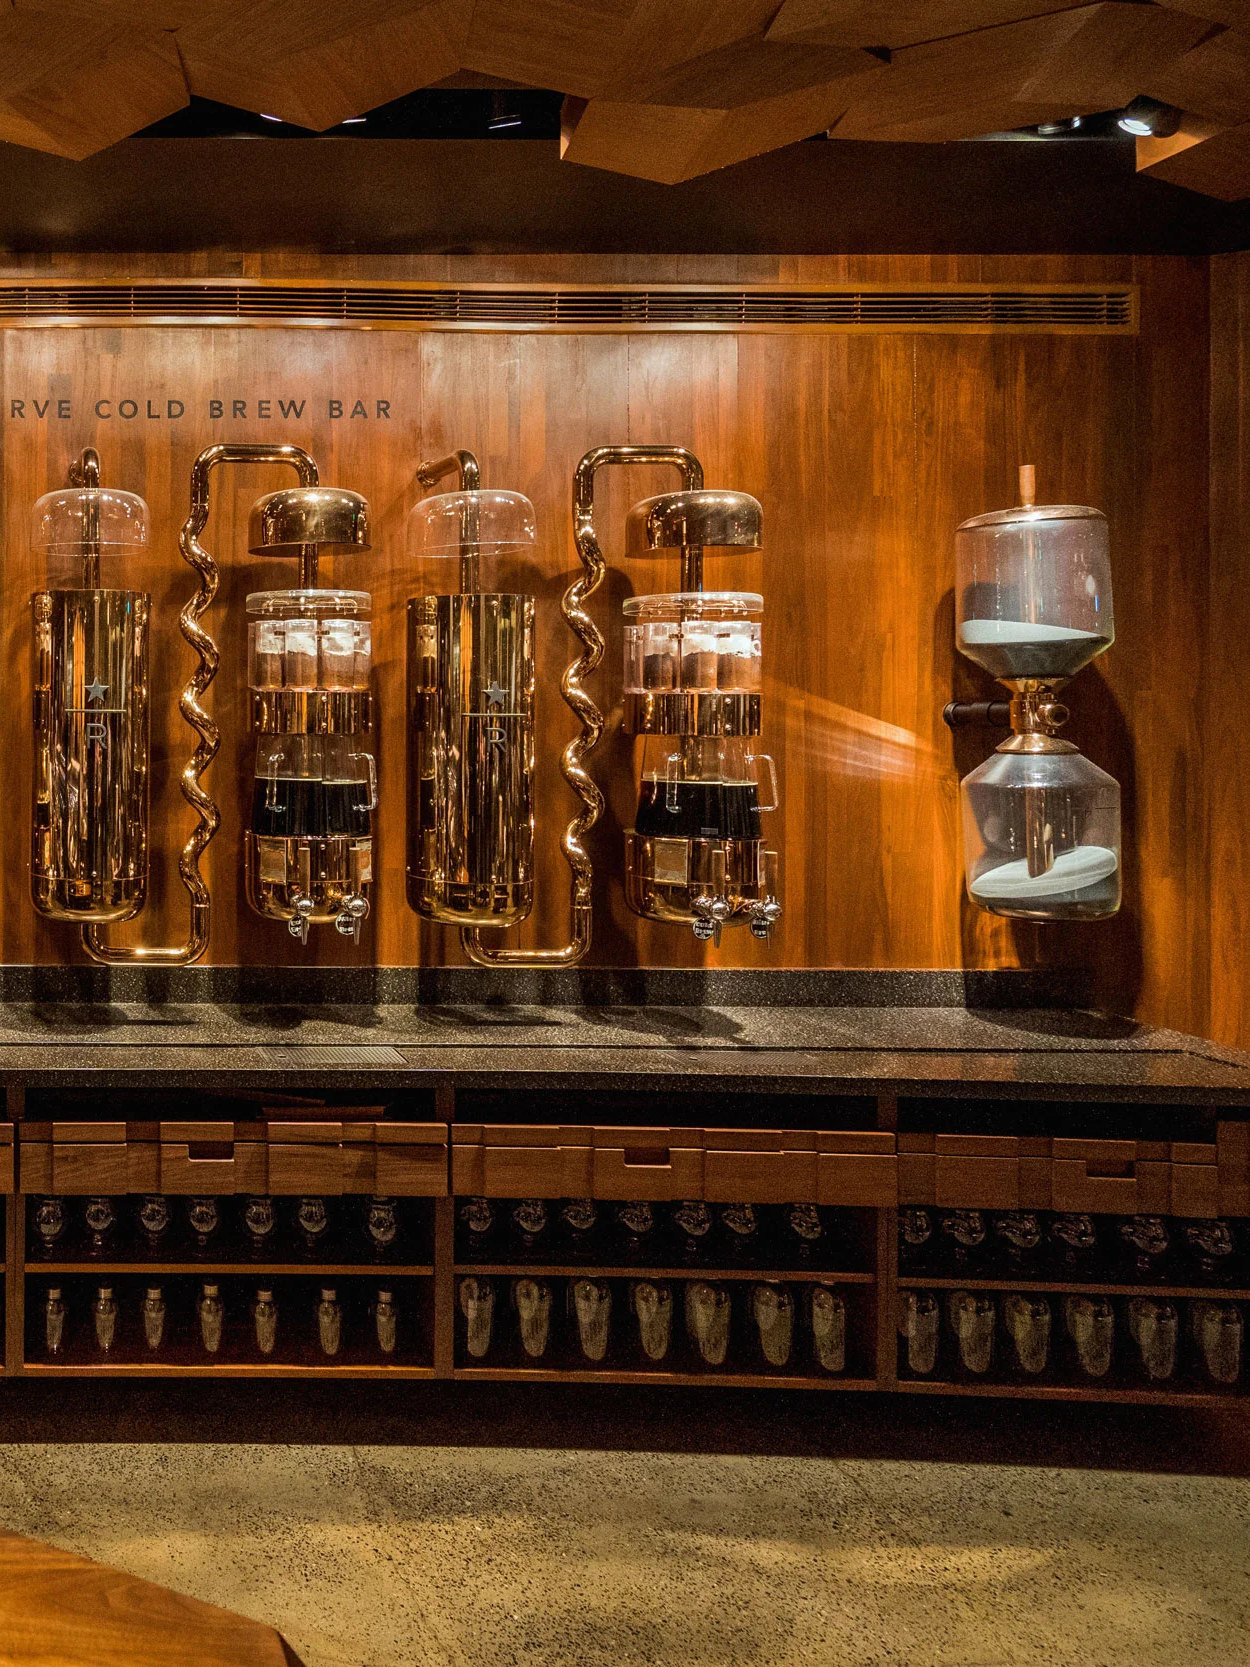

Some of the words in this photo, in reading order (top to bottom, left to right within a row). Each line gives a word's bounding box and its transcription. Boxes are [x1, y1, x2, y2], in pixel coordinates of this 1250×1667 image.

[95, 399, 185, 419] COLD
[209, 399, 306, 419] BREW
[328, 399, 391, 419] BAR
[86, 723, 108, 749] R
[486, 727, 507, 753] R
